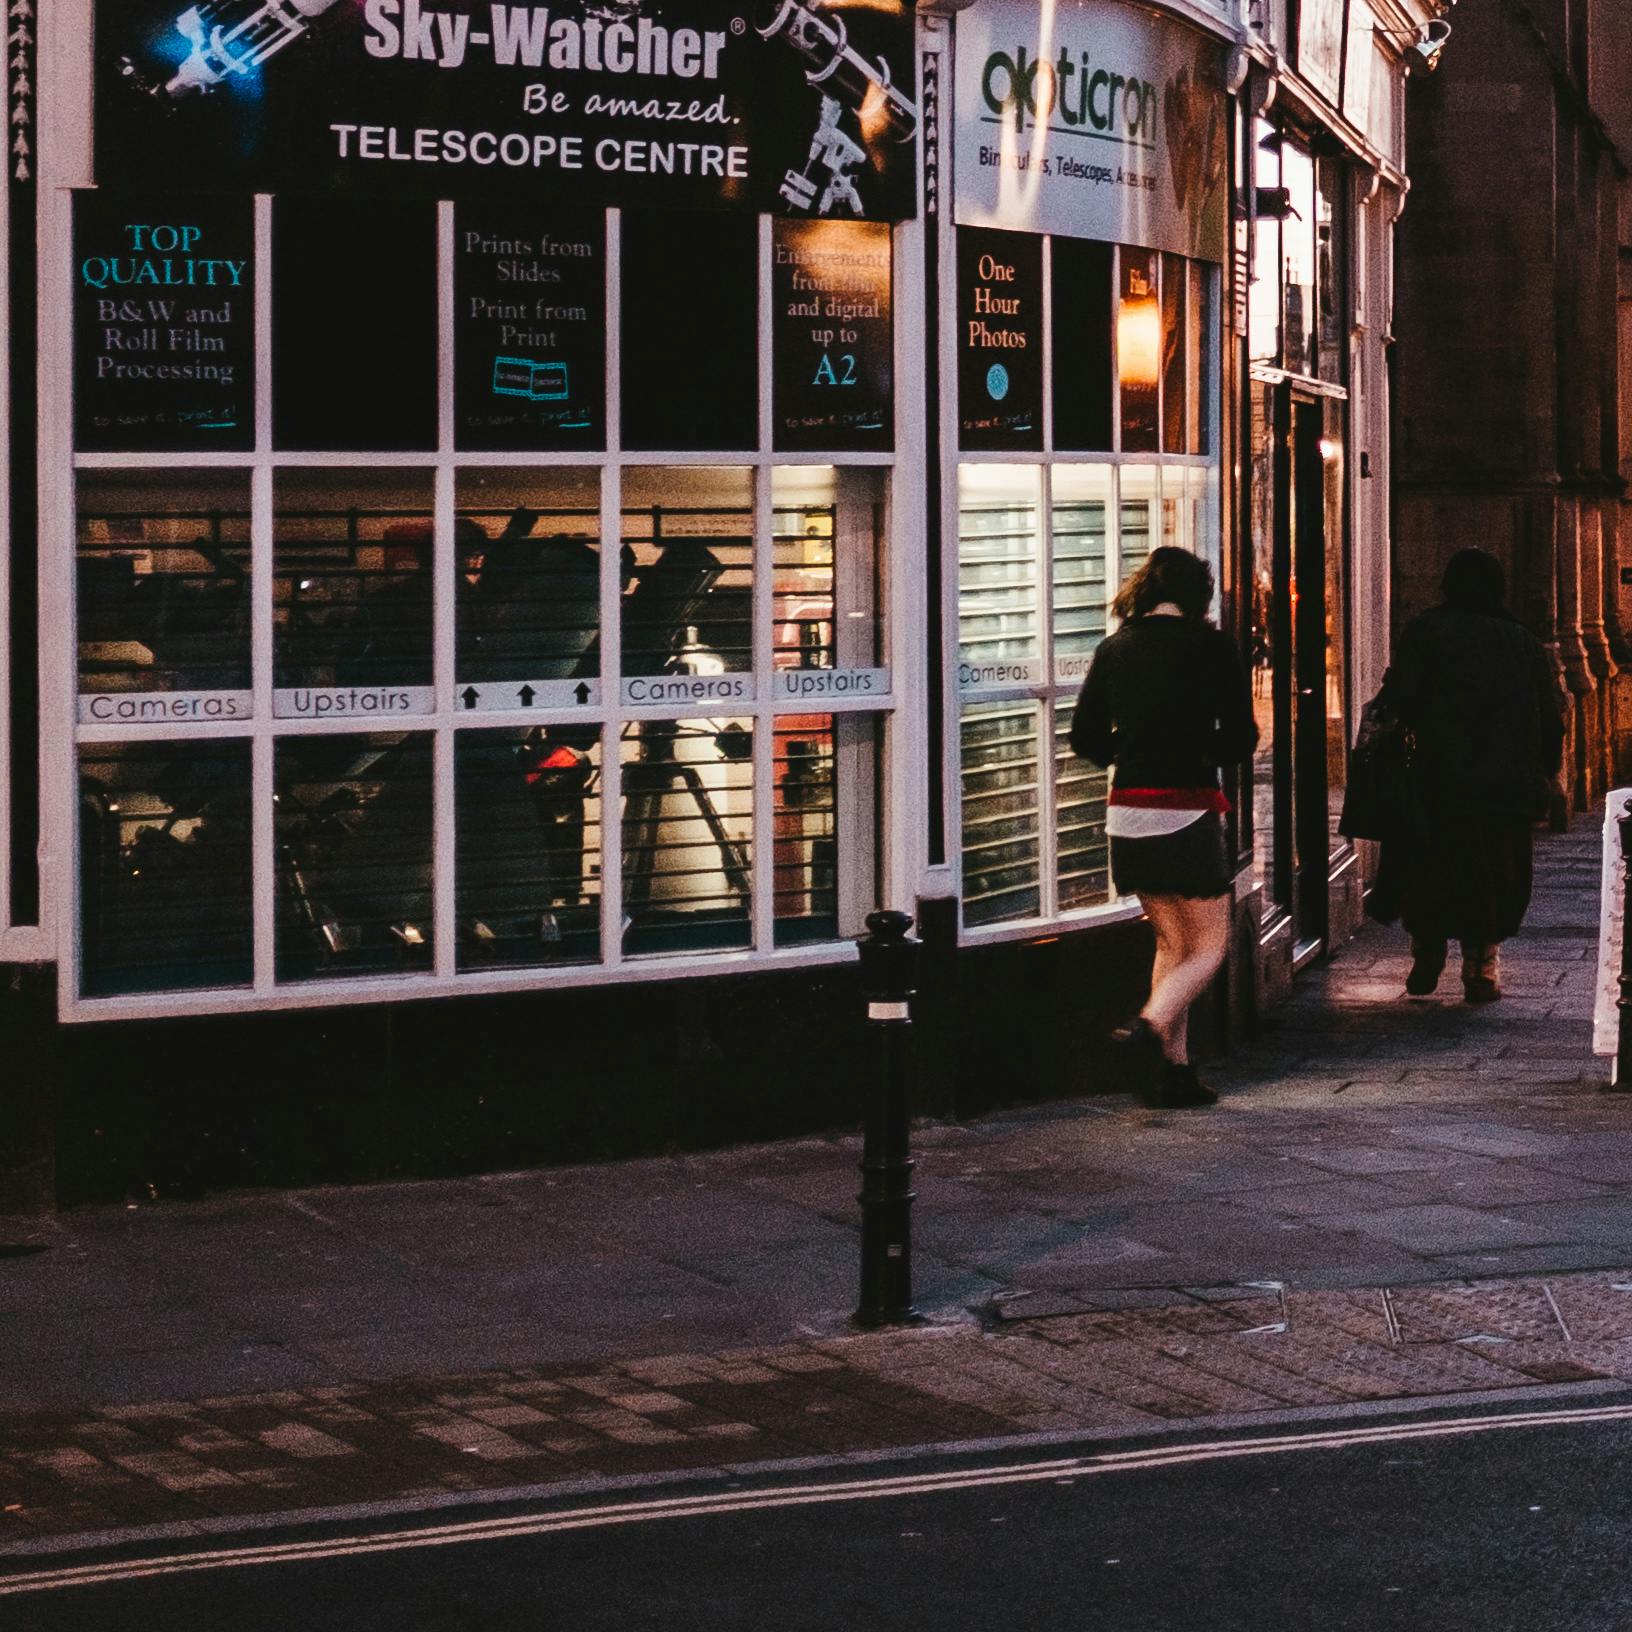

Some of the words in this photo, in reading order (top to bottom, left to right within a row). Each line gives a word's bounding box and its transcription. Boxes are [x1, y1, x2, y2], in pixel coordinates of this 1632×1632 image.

[523, 82, 569, 115] Be
[586, 91, 741, 125] amazed.
[982, 46, 1157, 141] opticron
[331, 123, 583, 169] TELESCOPE
[596, 138, 748, 178] CENTRE
[125, 225, 201, 251] TOP
[465, 232, 532, 255] Prints
[541, 234, 592, 257] from
[82, 257, 246, 288] QUALITY
[498, 260, 560, 282] Slides
[978, 255, 1015, 282] One
[98, 299, 175, 322] B&W
[186, 302, 231, 323] and
[471, 297, 527, 319] Print
[536, 299, 587, 321] from
[787, 296, 819, 316] and
[825, 296, 881, 322] digital
[974, 288, 1020, 315] Hour
[105, 328, 157, 351] Roll
[168, 329, 225, 352] Film
[501, 325, 557, 347] Print
[811, 328, 834, 348] up
[840, 327, 858, 343] to
[968, 321, 1026, 349] Photos
[96, 356, 234, 384] Processing
[811, 353, 858, 385] A2
[626, 675, 745, 703] Cameras
[785, 671, 873, 698] Upstairs
[959, 663, 1029, 684] Cameras
[89, 691, 239, 722] Cameras
[293, 686, 411, 716] Upstairs
